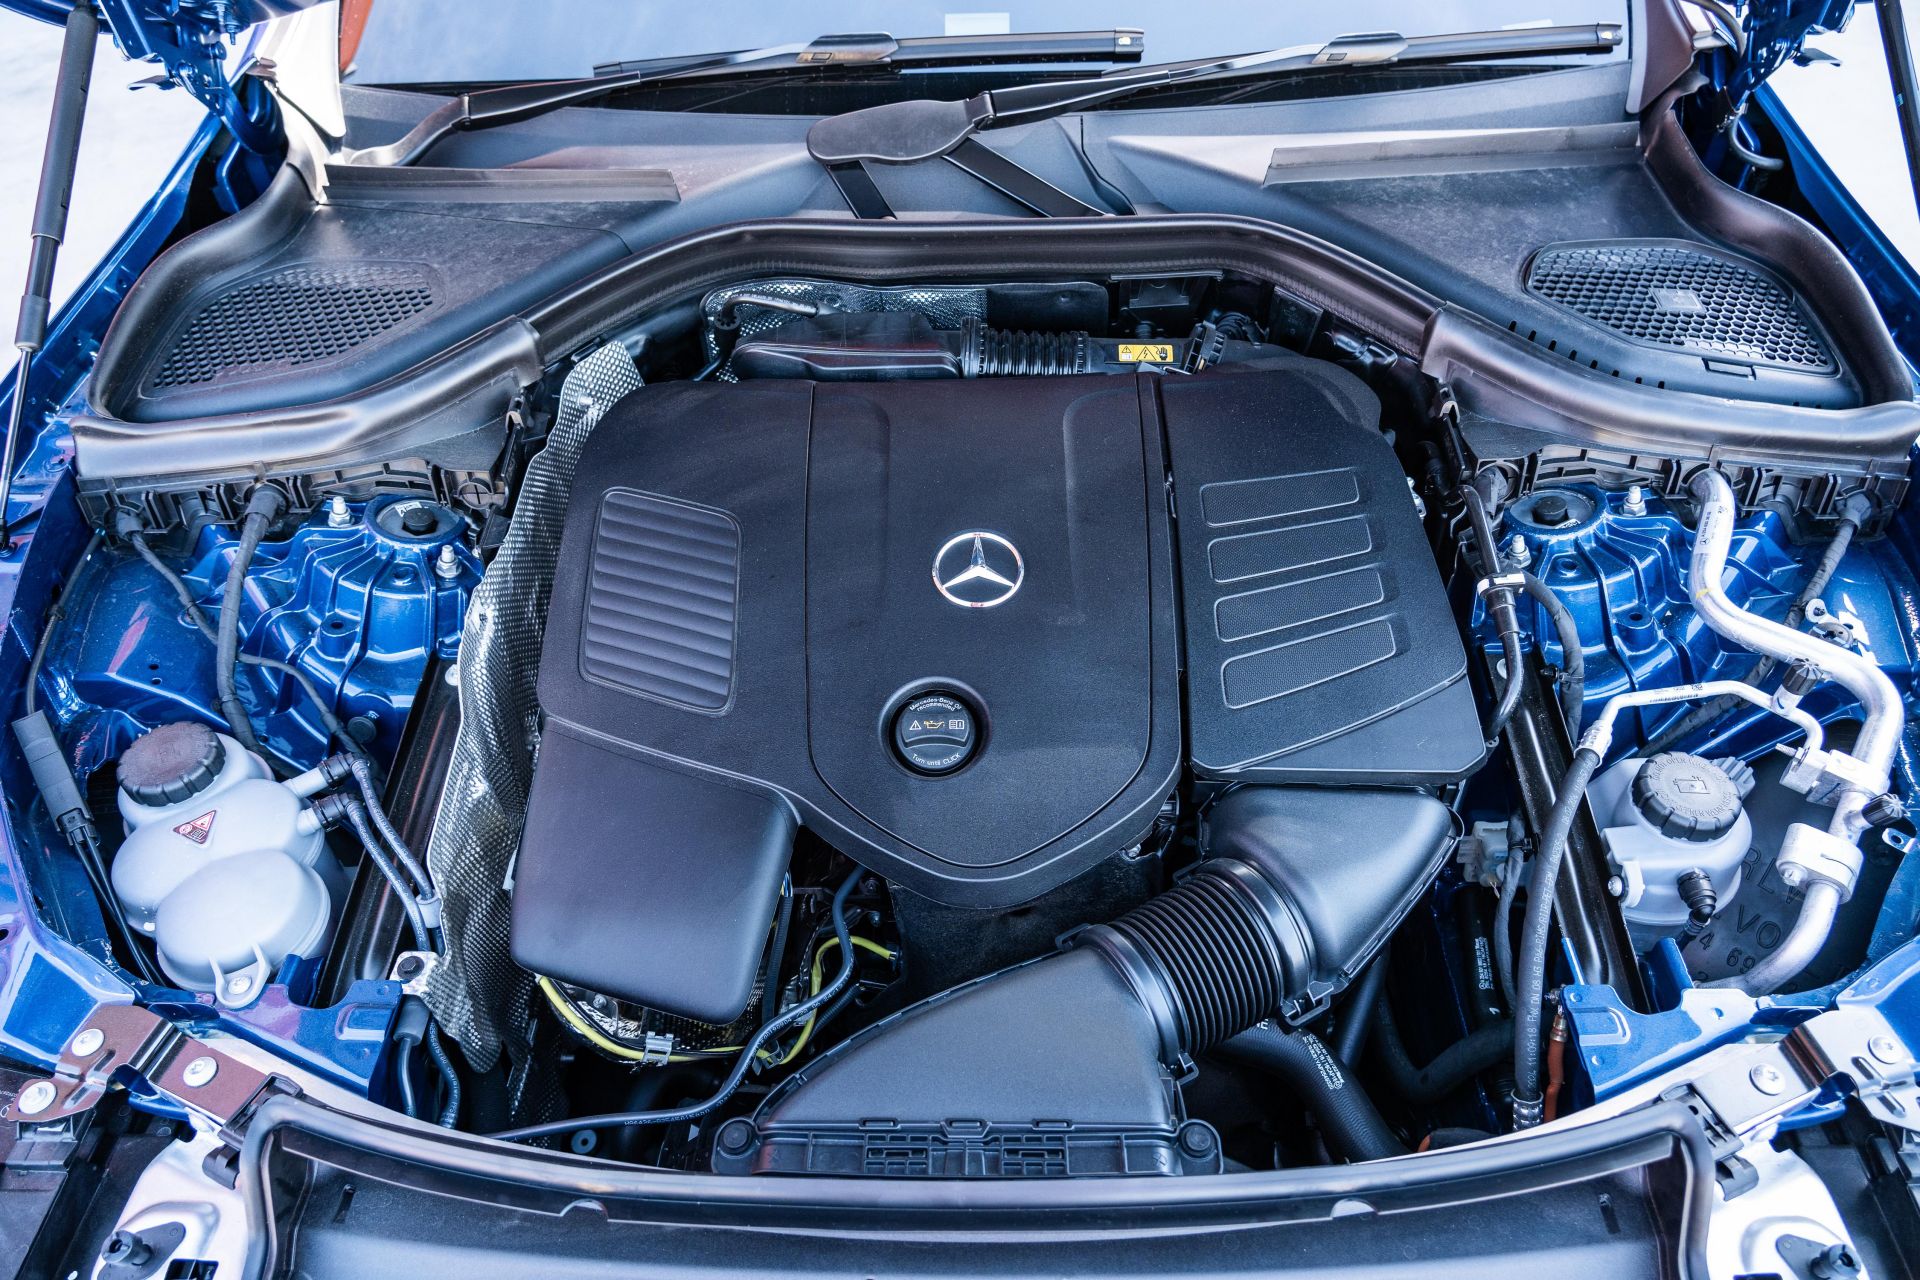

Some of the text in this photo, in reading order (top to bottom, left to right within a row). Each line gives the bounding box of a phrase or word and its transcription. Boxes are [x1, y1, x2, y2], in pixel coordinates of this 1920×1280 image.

[909, 697, 954, 711] Mercedes-Benz
[916, 702, 955, 712] recommended
[912, 752, 925, 765] Turn
[943, 752, 961, 765] CLICK
[1530, 992, 1541, 1005] DN
